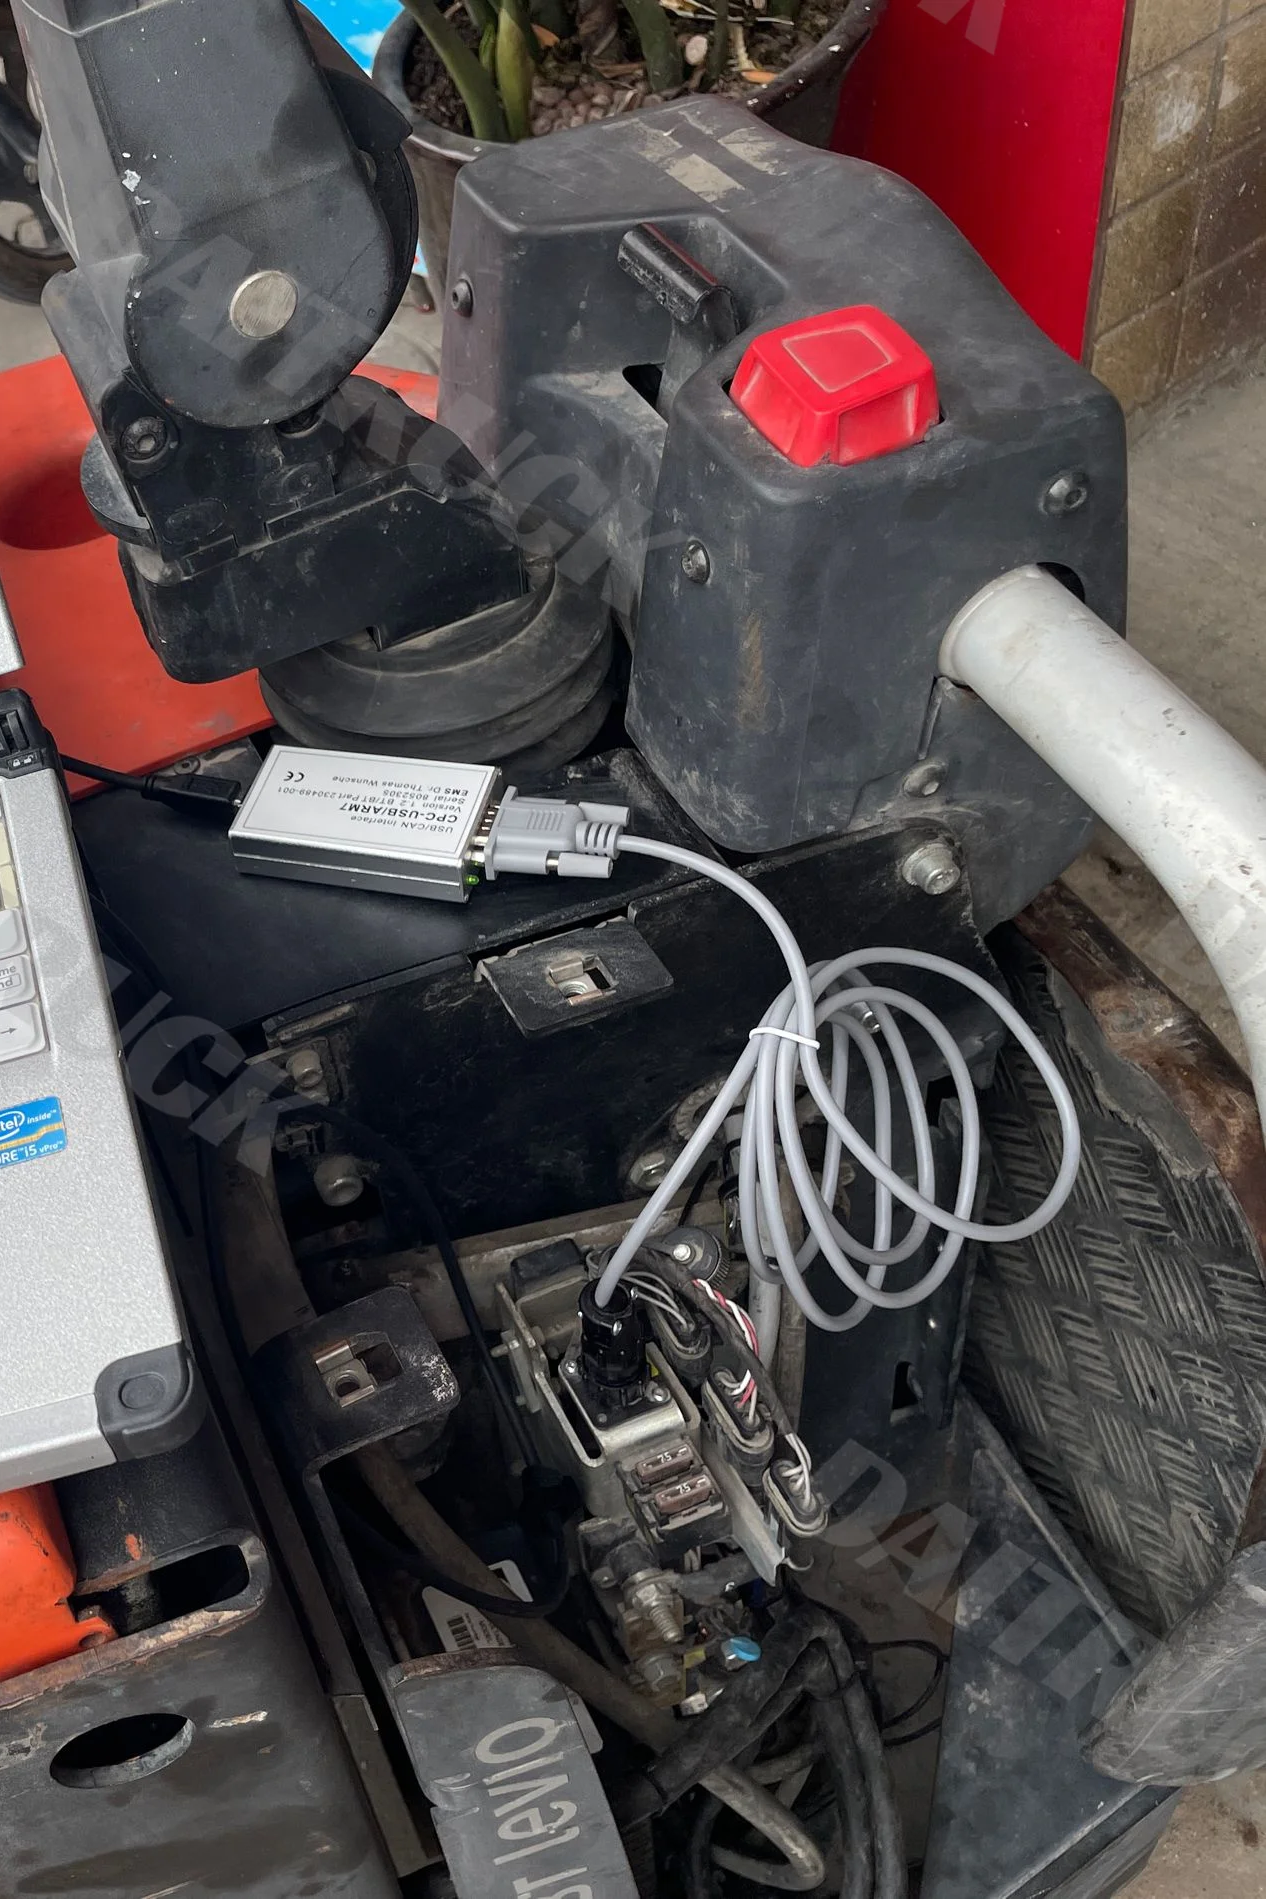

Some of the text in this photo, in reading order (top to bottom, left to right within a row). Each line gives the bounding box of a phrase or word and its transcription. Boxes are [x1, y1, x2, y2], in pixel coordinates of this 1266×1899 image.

[283, 771, 304, 782] CE
[382, 781, 423, 791] Thomas
[338, 792, 359, 801] Part
[445, 788, 468, 796] EMS
[434, 795, 466, 805] Serial
[422, 802, 462, 812] Version
[339, 802, 458, 823] CPC-USB/ARM7
[24, 1144, 37, 1157] i5
